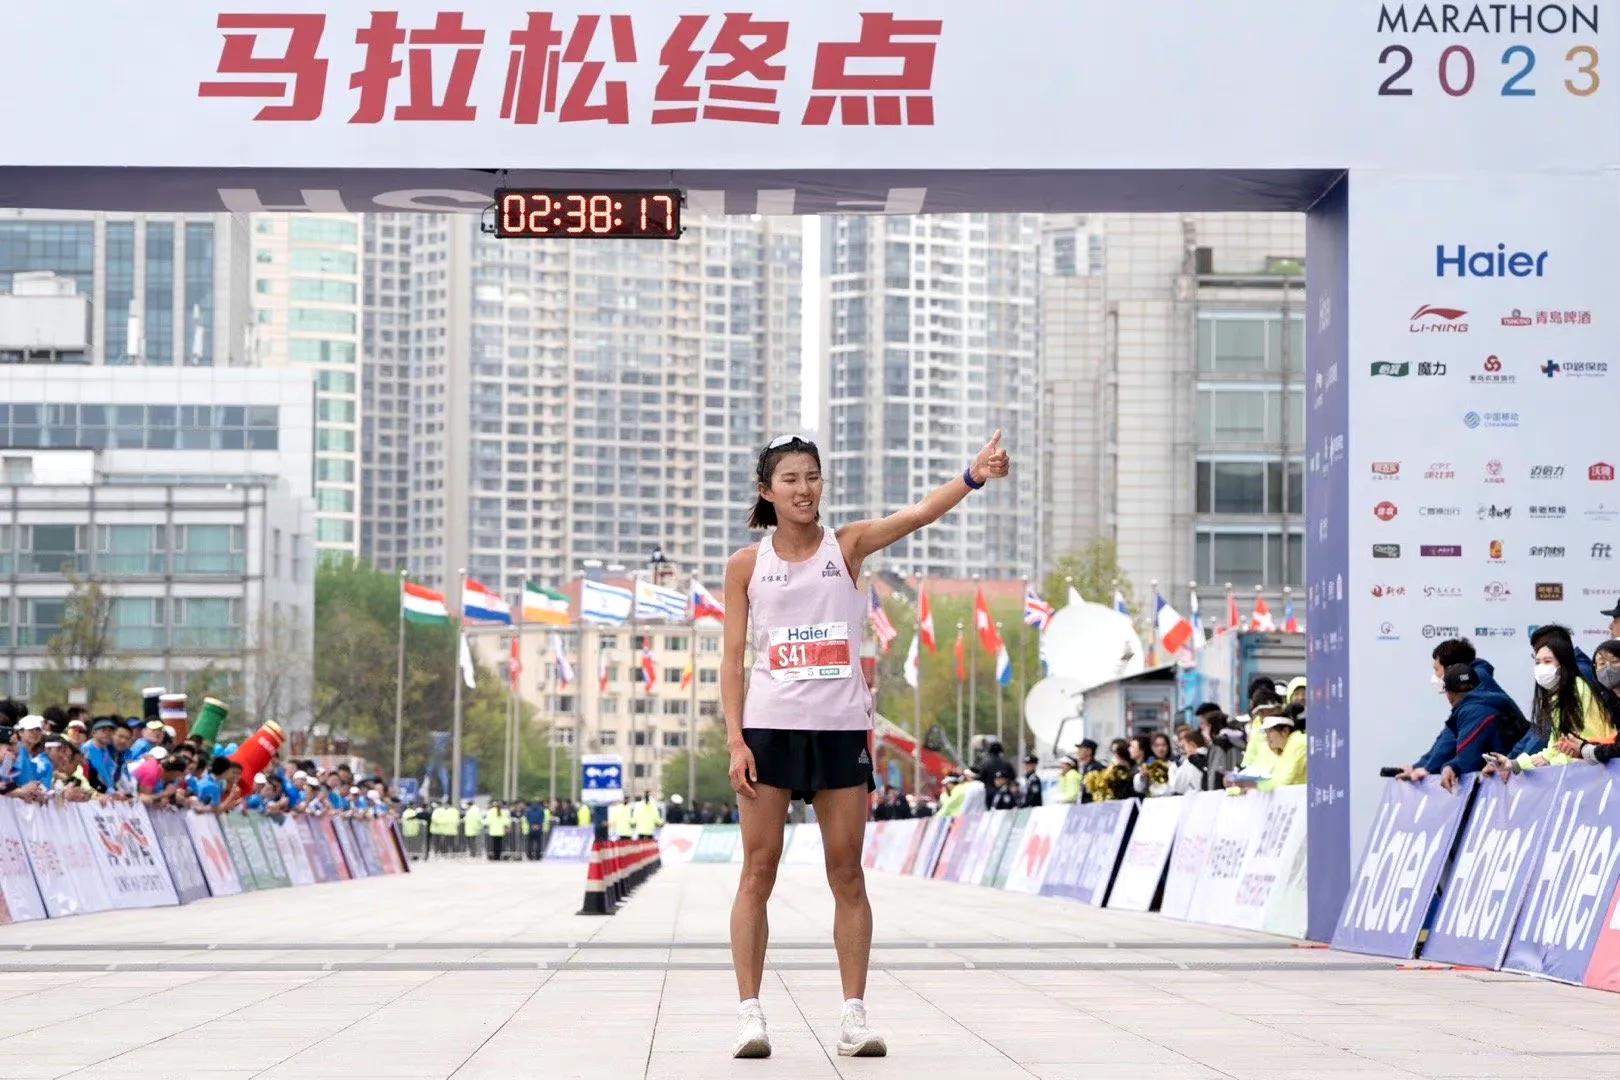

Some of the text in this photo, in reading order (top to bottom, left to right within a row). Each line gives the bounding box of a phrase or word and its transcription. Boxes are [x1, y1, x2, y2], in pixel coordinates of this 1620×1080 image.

[1377, 4, 1599, 34] MARATHON
[198, 11, 944, 127] 马拉松终点
[1378, 44, 1601, 97] 2023
[1436, 242, 1549, 278] Haier
[1409, 323, 1469, 333] LI-NING
[1418, 361, 1447, 376] 魔力
[822, 570, 842, 578] PEAK
[787, 626, 829, 641] Haier
[777, 644, 807, 667] S41
[1343, 794, 1446, 934] Haier
[1435, 788, 1538, 941] Haier
[1519, 778, 1620, 951] Haier
